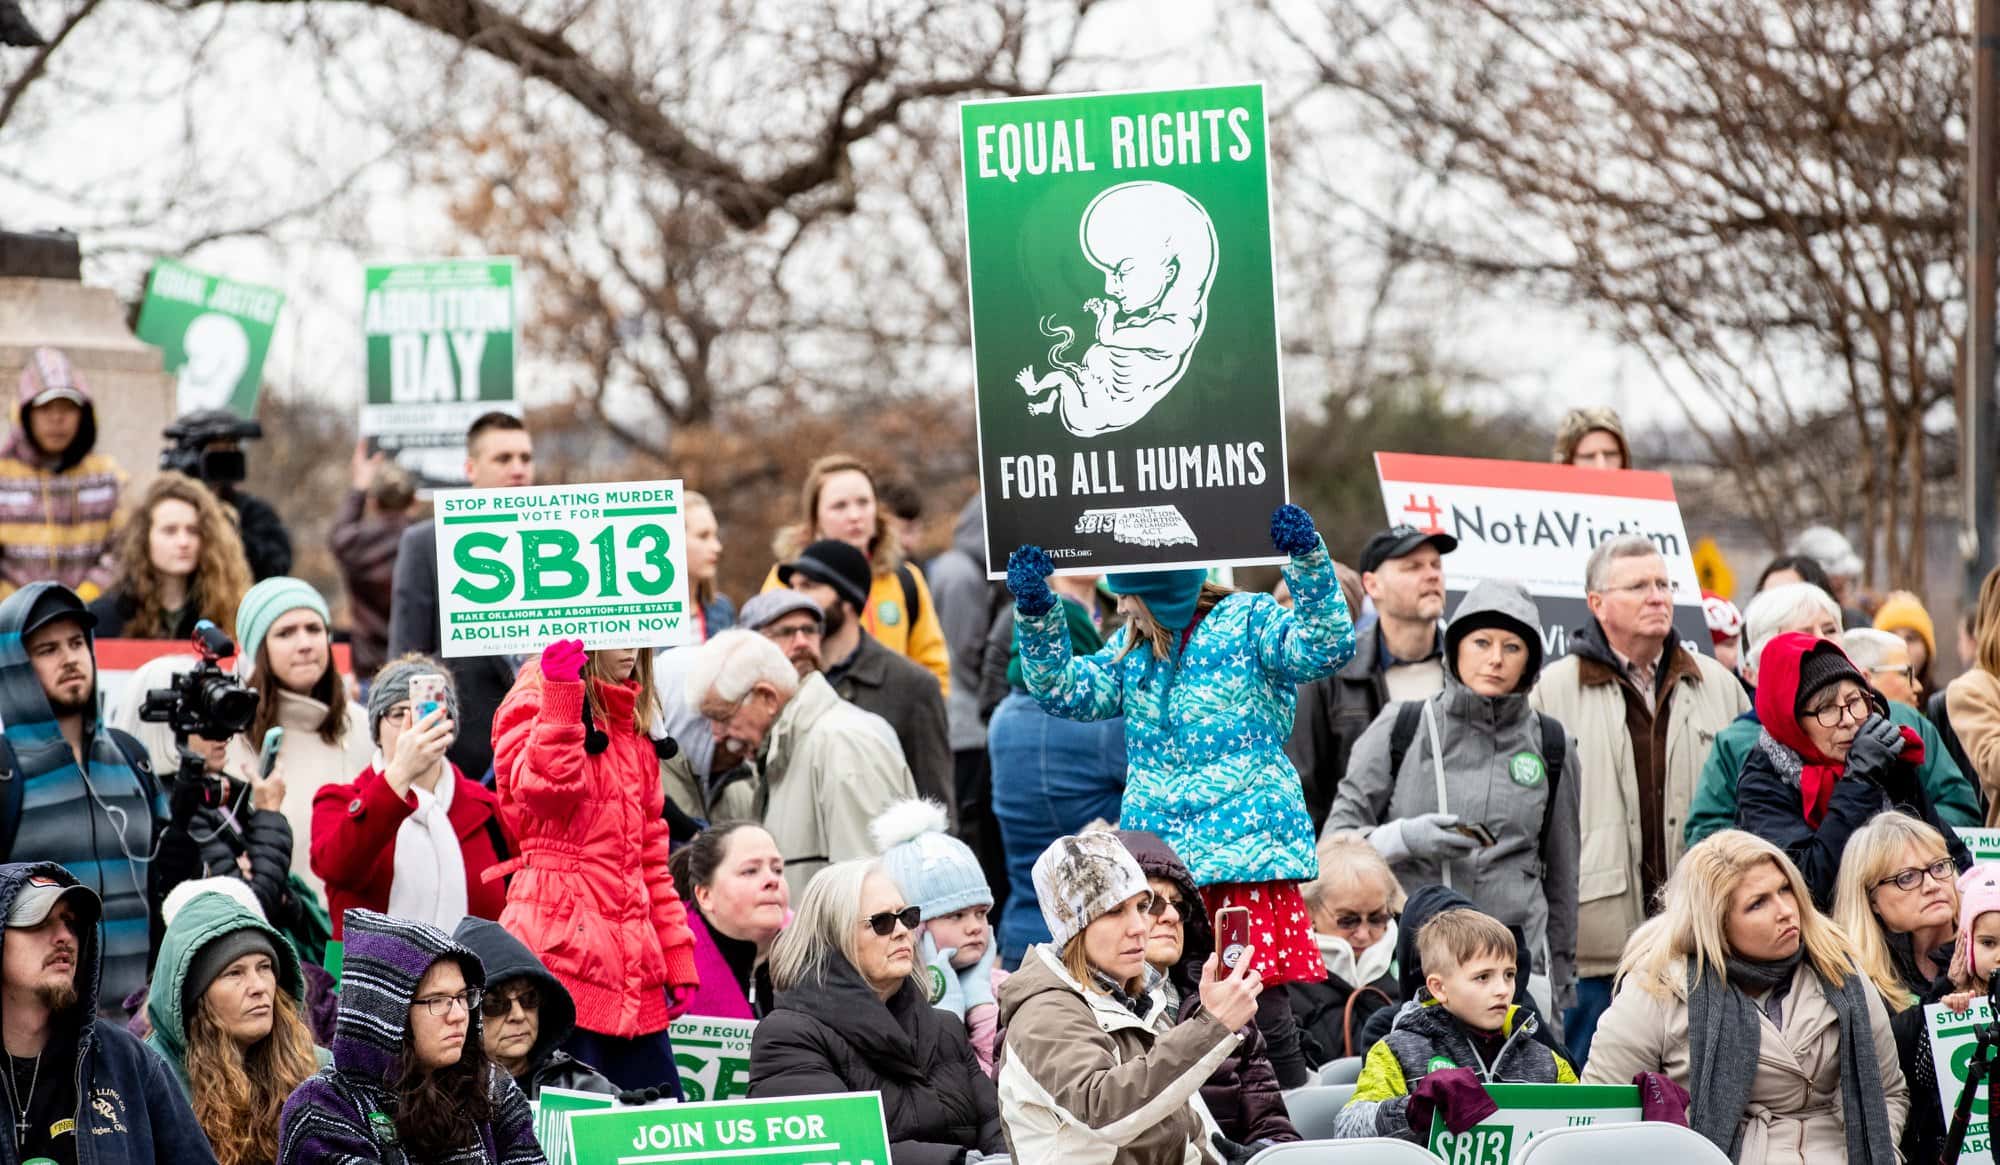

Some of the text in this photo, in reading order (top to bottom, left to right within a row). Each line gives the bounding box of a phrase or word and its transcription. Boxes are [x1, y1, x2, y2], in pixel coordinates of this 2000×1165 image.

[977, 107, 1251, 183] EQUAL RIGHTS
[366, 287, 511, 335] ABOLITION
[391, 331, 488, 401] DAY
[1000, 441, 1267, 499] FOR ALL HUMANS
[445, 490, 674, 511] STOP REGULATING MURDER
[522, 509, 599, 521] VOTE FOR
[1074, 513, 1116, 533] SB13
[1123, 511, 1176, 519] ABOLITION
[1403, 494, 1680, 556] #NotAVicm
[451, 523, 675, 604] SB13
[457, 603, 674, 622] MAKE OKLAHOMA AN ABORTION-FREE STATE
[451, 617, 680, 641] ABOLISH ABORTION NOW
[1936, 1008, 1974, 1024] STOP
[669, 1023, 752, 1039] TOP REGUL
[726, 1041, 752, 1051] VOT
[632, 1114, 827, 1150] JOIN US FOR
[1436, 1131, 1505, 1165] SB13
